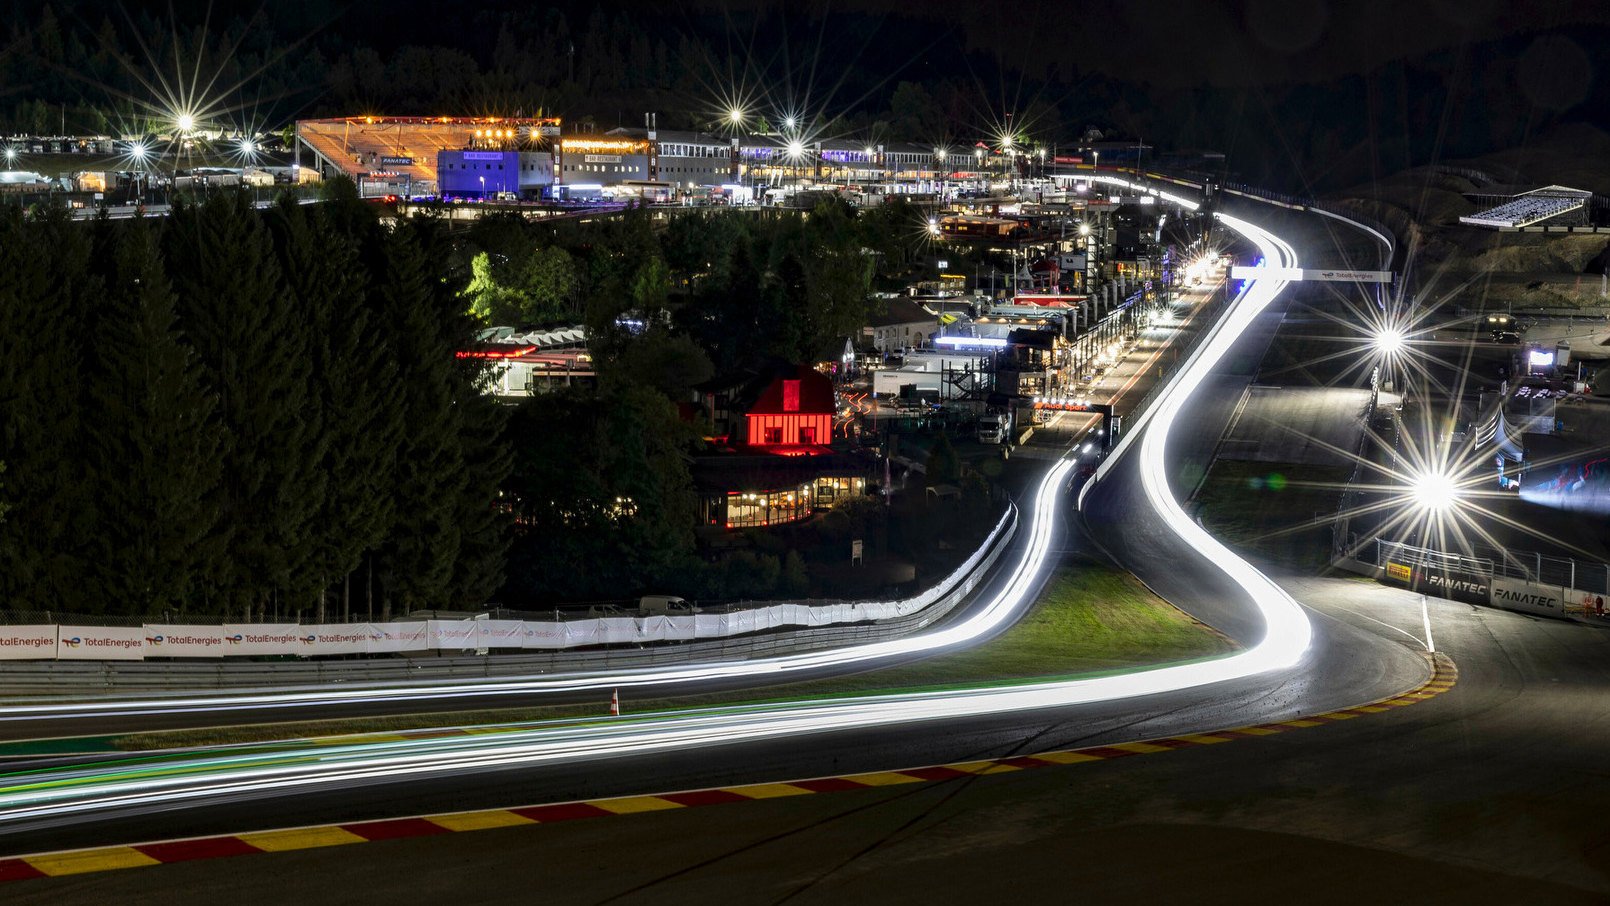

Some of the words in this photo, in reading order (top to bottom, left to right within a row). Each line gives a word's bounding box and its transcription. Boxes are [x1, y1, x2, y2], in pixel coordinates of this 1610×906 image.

[1429, 576, 1487, 594] FANATEC
[1495, 589, 1556, 607] FANATEC
[84, 637, 142, 648] TotalEnergies
[166, 635, 221, 646] TotalEnergies
[245, 634, 297, 644] TotalEnergies
[318, 633, 366, 643] TotalEnergies
